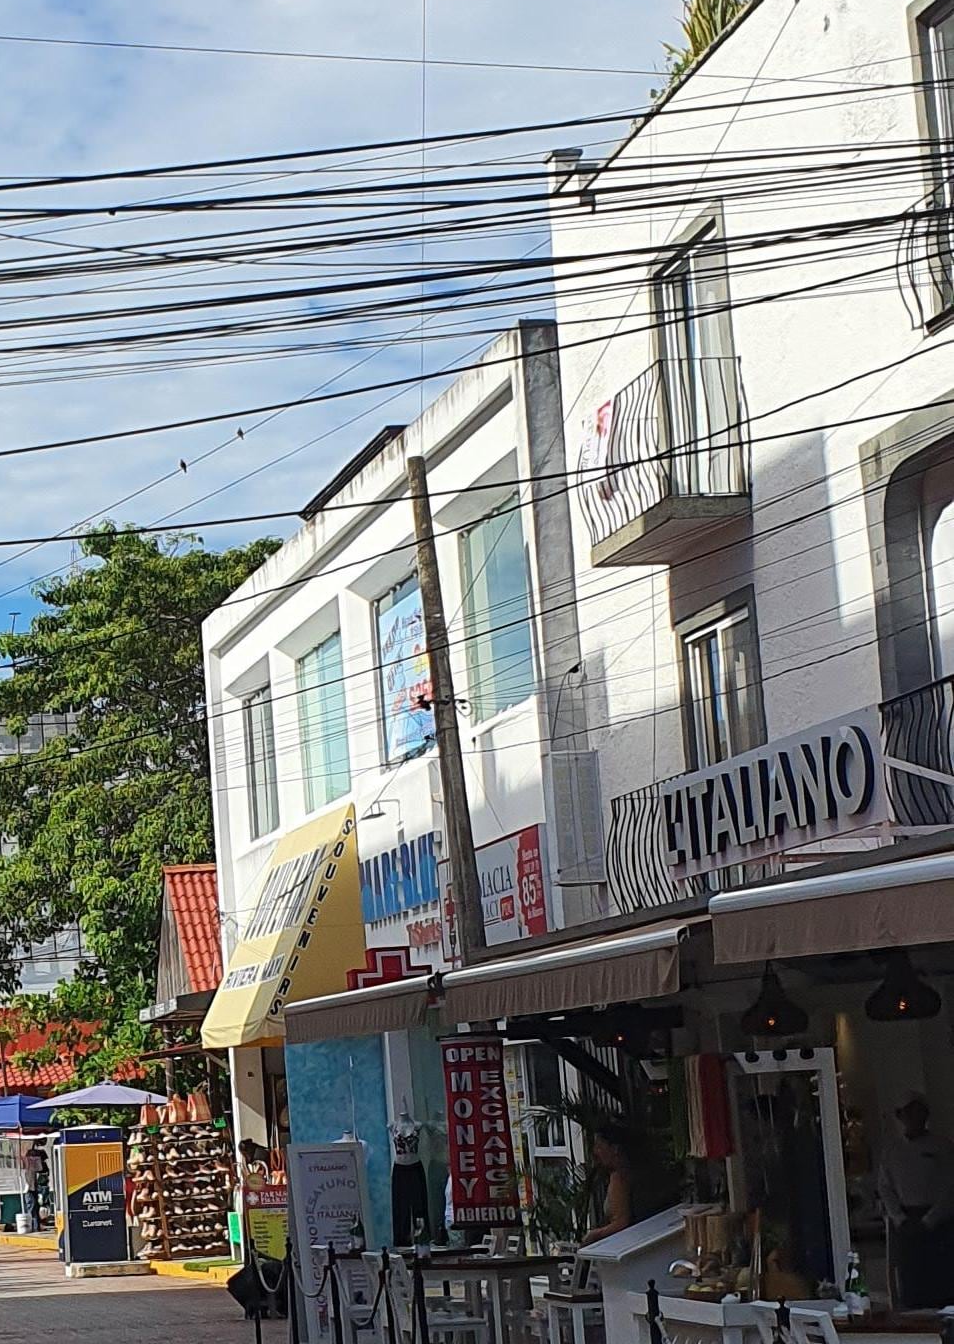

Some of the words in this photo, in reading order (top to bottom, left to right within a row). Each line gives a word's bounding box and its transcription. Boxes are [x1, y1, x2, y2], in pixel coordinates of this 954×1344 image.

[269, 818, 354, 1016] SOUVENIRS
[445, 1047, 500, 1063] OPEN
[450, 1071, 478, 1199] MONEY
[479, 1070, 510, 1199] EXCHANGE
[82, 1191, 112, 1203] ATM
[456, 1206, 517, 1222] ABIERTO
